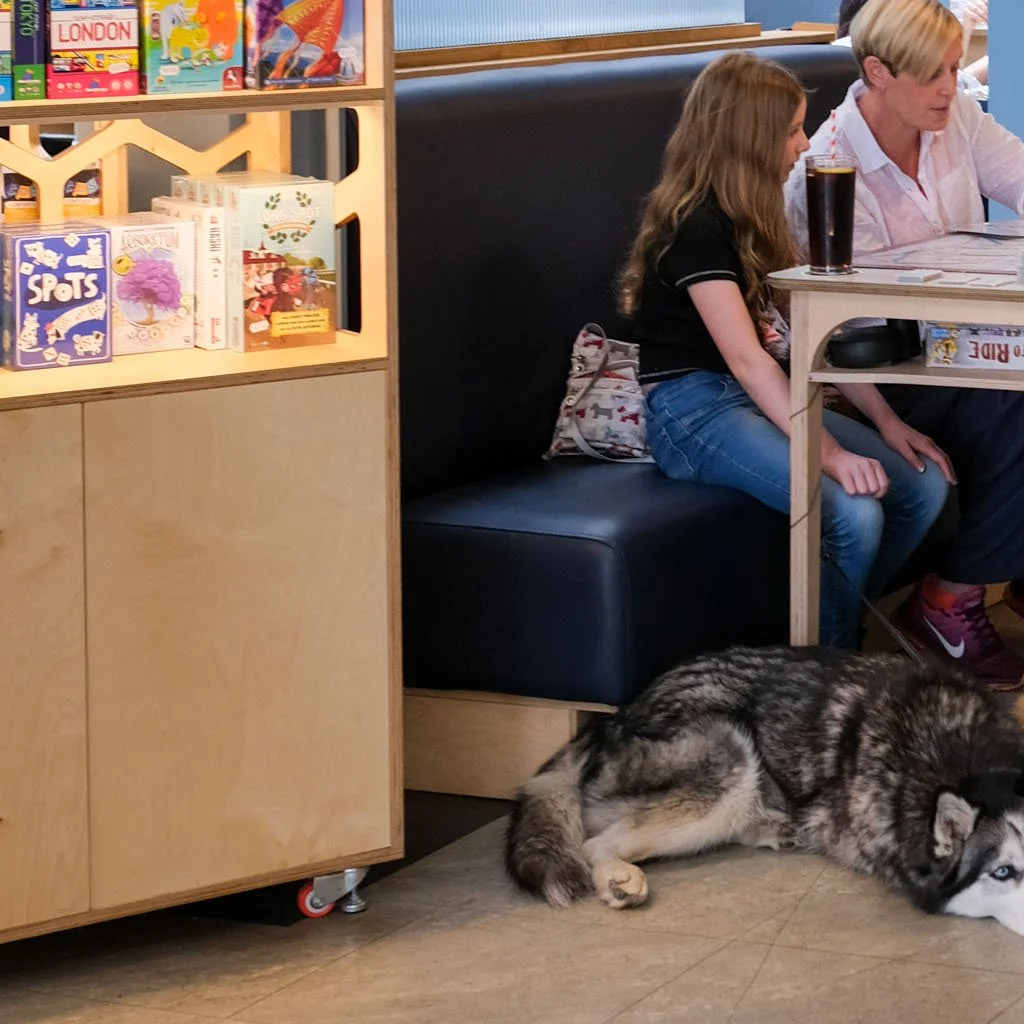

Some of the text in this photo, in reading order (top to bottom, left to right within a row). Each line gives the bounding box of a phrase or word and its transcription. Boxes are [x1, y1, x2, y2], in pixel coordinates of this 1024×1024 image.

[59, 21, 132, 42] LONDON
[27, 272, 98, 305] SPOTS
[968, 341, 1010, 364] RIDE
